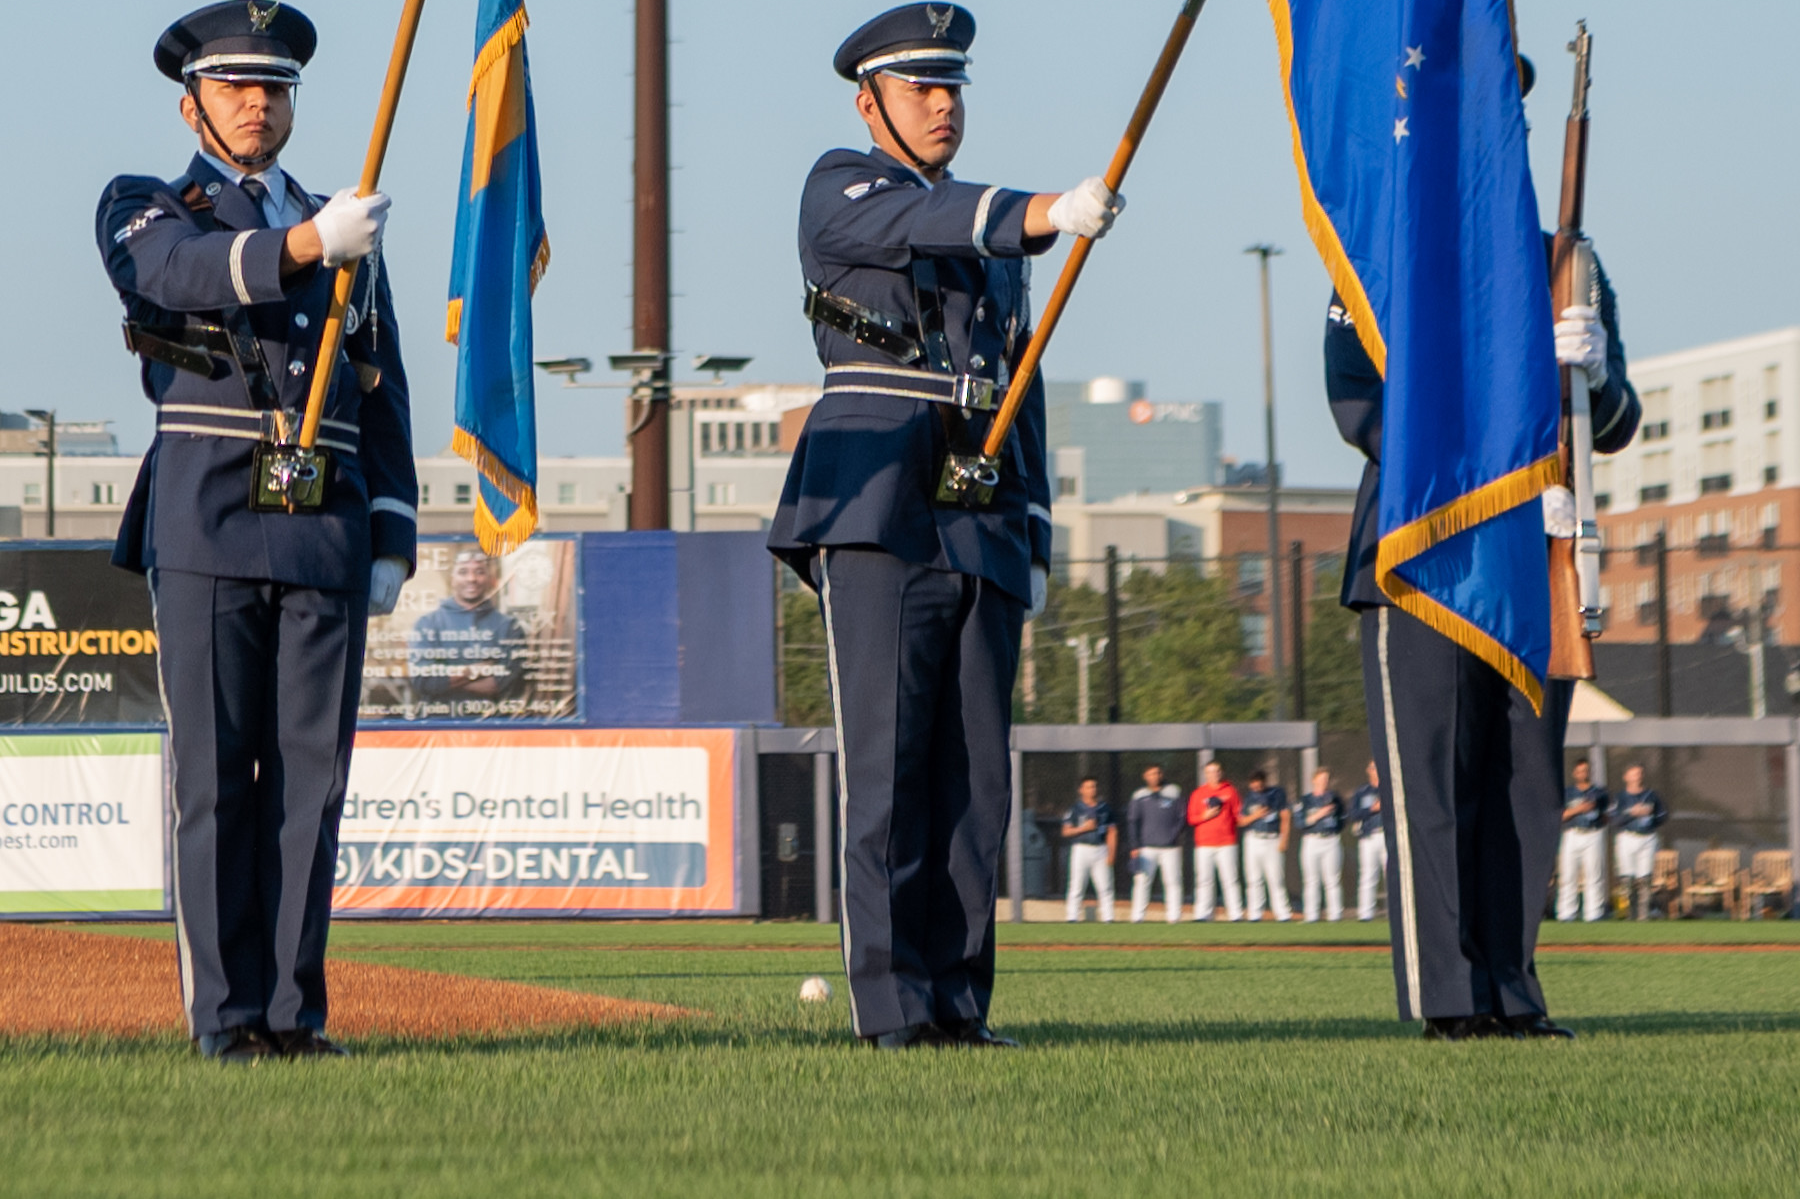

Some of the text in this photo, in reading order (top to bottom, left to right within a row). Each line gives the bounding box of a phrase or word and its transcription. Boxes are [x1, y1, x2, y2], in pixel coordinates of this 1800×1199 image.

[439, 626, 494, 642] make
[373, 648, 459, 662] everyone
[462, 644, 507, 659] else.
[363, 666, 387, 678] ou
[390, 666, 403, 678] a
[408, 663, 467, 677] better
[467, 666, 511, 681] you.
[2, 801, 130, 826] CONTROL
[340, 790, 702, 820] dren's Dental Health
[372, 847, 649, 882] KIDS-DENTAL
